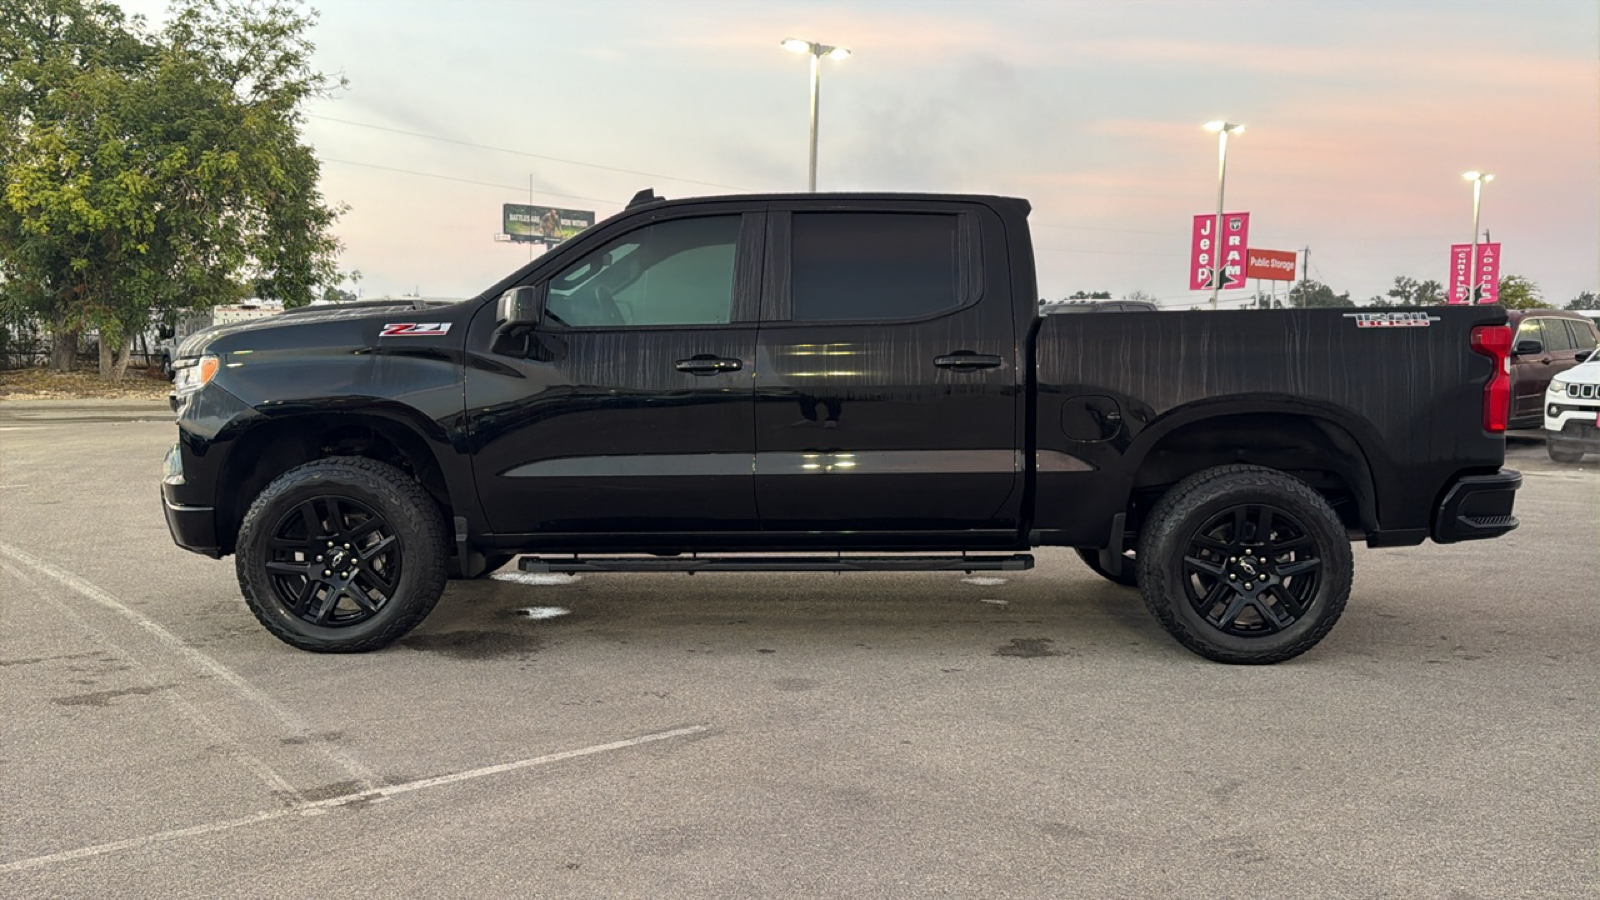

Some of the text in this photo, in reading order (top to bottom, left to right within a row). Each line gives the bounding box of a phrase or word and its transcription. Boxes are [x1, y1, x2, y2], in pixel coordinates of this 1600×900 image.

[1197, 219, 1211, 283] Jeep
[1225, 235, 1241, 275] RAM
[1250, 256, 1294, 272] Public Storage
[379, 322, 453, 336] Z71
